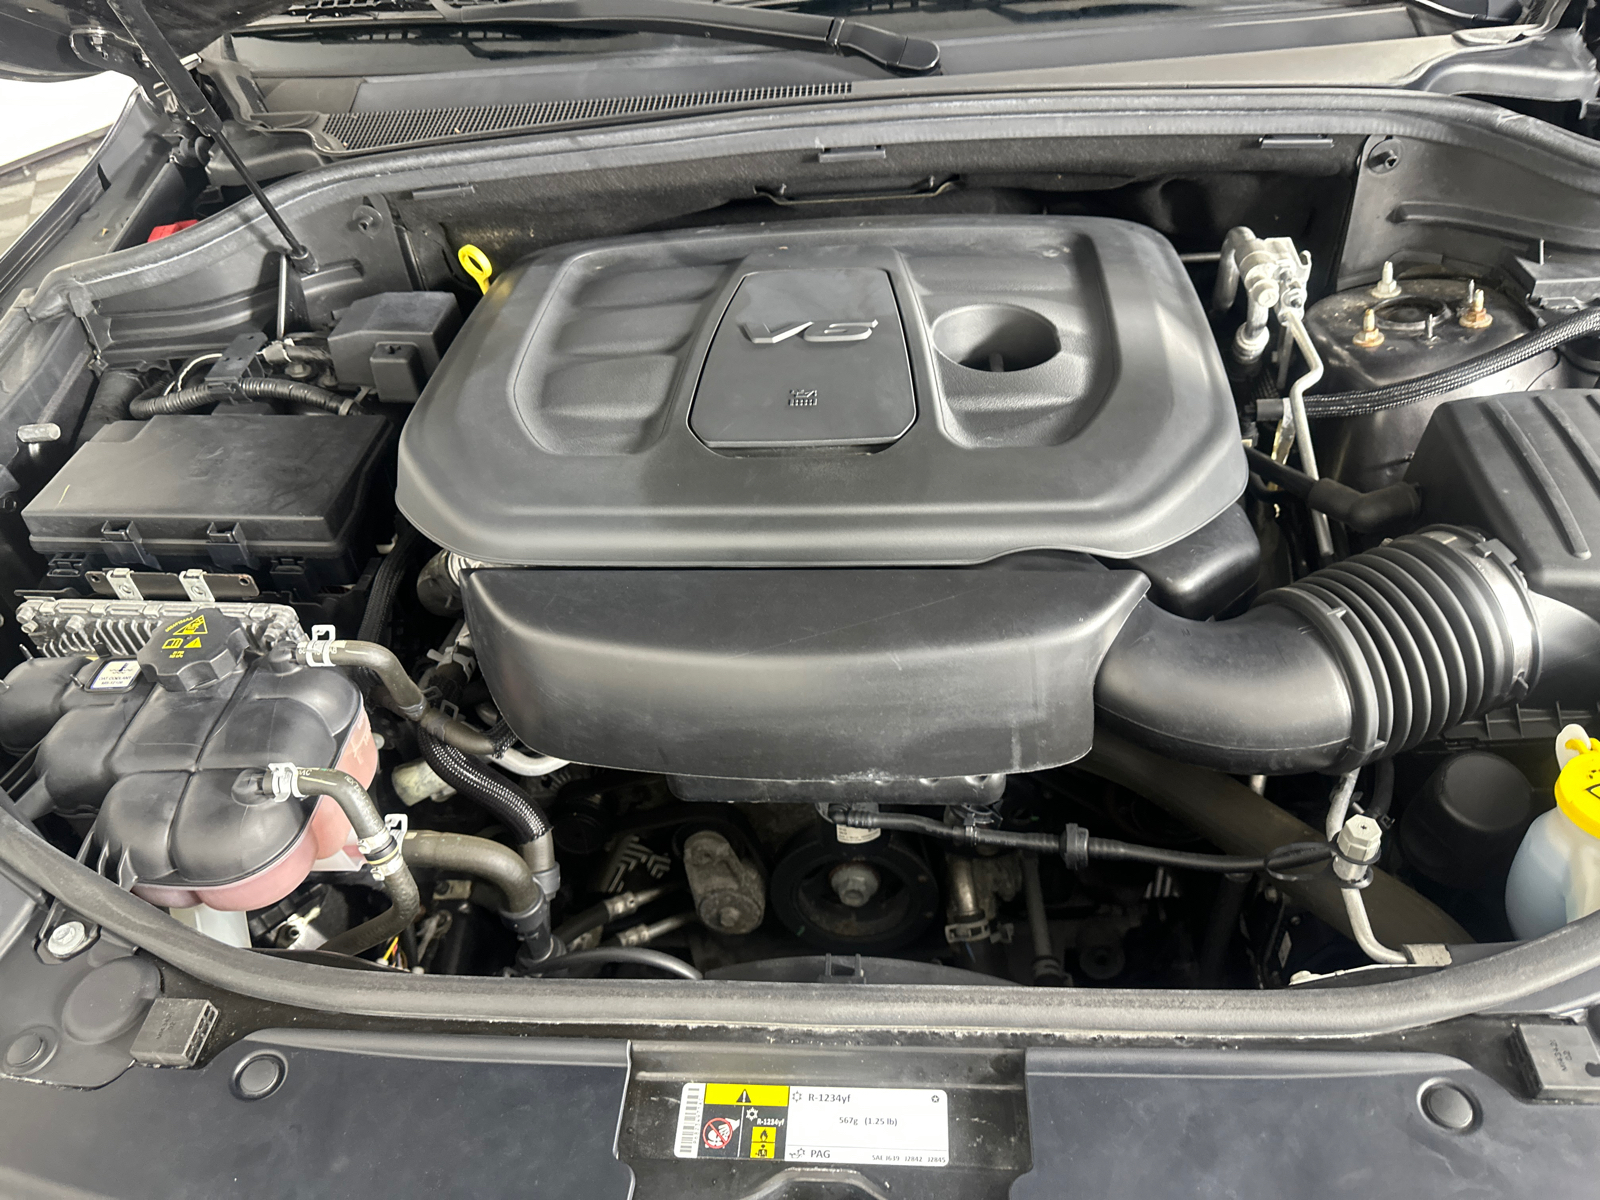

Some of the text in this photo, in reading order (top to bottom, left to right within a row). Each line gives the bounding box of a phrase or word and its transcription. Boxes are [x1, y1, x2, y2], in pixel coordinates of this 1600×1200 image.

[737, 318, 879, 345] V6
[808, 1093, 851, 1104] R-1234yf
[756, 1118, 785, 1127] R-1234yf
[839, 1116, 898, 1127] 567g (1.25 lb)
[810, 1149, 831, 1159] PAG
